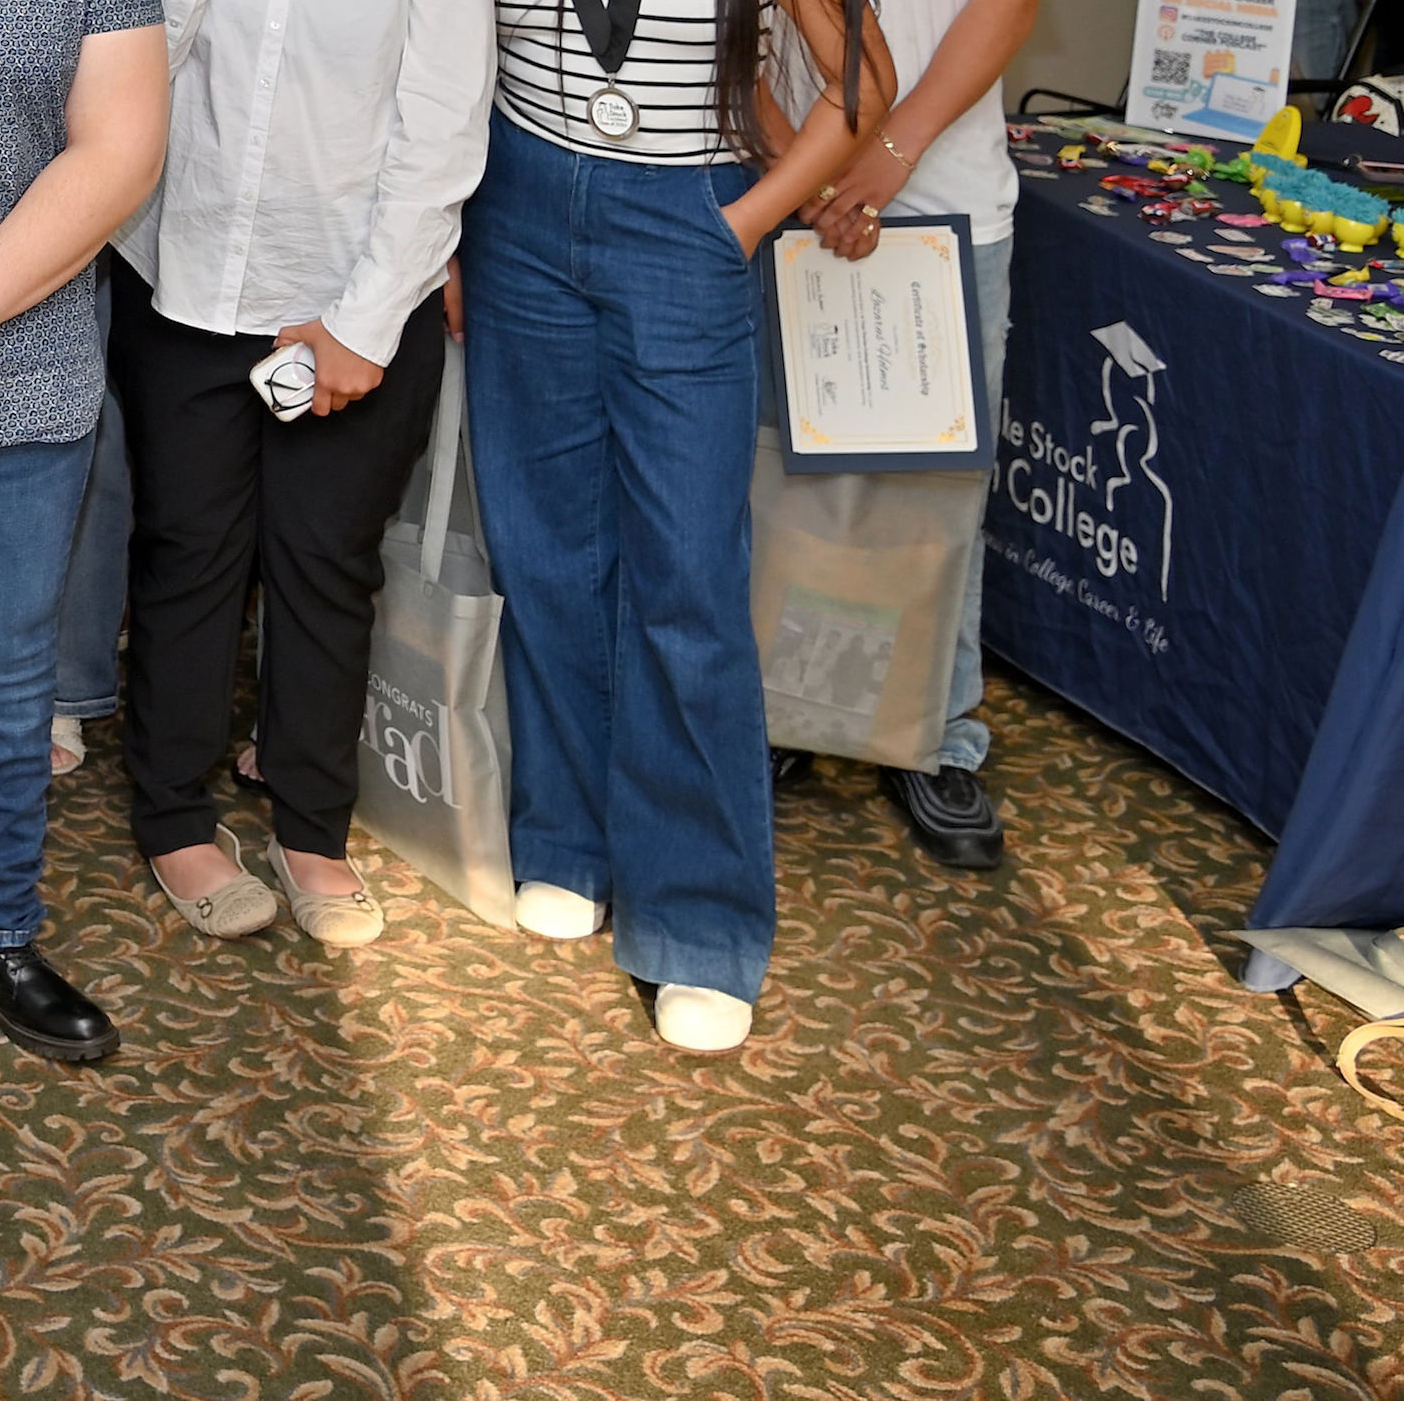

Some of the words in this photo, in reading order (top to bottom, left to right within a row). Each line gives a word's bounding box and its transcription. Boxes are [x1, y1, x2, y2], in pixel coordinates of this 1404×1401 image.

[911, 281, 924, 328] Certificate
[917, 342, 930, 396] Scholarship
[1029, 421, 1098, 490] Stock
[1007, 458, 1140, 578] College
[1144, 618, 1170, 655] Life
[367, 670, 434, 727] ONGRATS
[358, 694, 465, 809] rad
